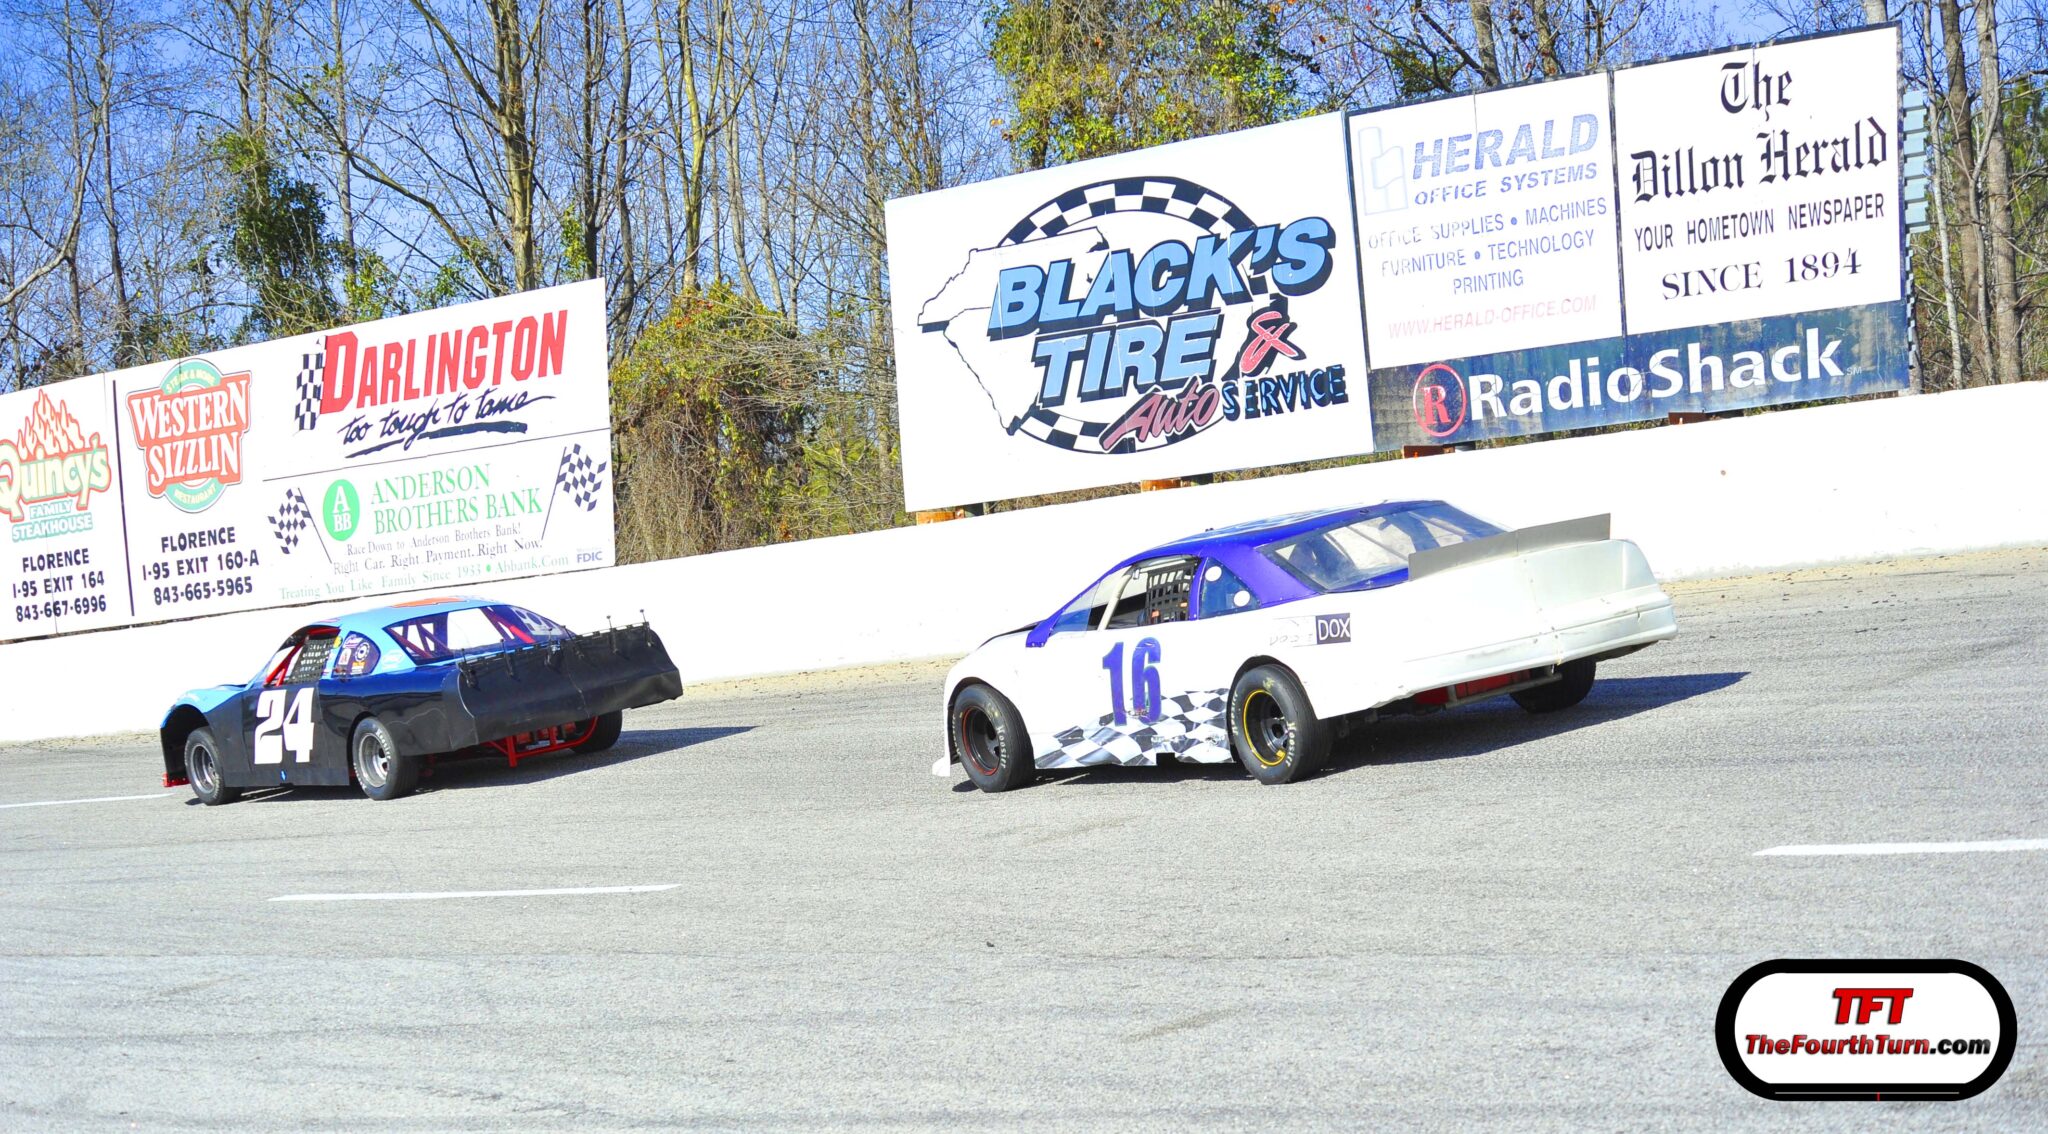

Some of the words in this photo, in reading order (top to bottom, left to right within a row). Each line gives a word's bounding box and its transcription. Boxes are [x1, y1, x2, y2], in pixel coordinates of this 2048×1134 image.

[1720, 61, 1792, 121] The
[1412, 113, 1599, 180] HERALD
[1630, 146, 1745, 204] Dillon
[1756, 117, 1888, 185] Herald
[1414, 181, 1487, 205] OFFICE
[1500, 162, 1597, 193] SYSTEMS
[1368, 226, 1422, 249] OFFICE
[1431, 214, 1504, 240] SUPPLIES
[1525, 197, 1607, 226] MACHINES
[1634, 224, 1674, 252] YOUR
[1687, 208, 1774, 245] HOMETOWN
[1788, 193, 1884, 230] NEWSPAPER
[1381, 249, 1467, 278] FURNITURE
[1488, 229, 1594, 261] TECHNOLOGY
[1662, 262, 1763, 300] SINCE
[1785, 248, 1861, 283] 1894
[986, 216, 1337, 342] BLACK'S
[1453, 269, 1524, 294] PRINTING
[1388, 295, 1596, 339] WWW.HERALD-OFFICE.COM
[319, 309, 568, 416] DARLINGTON
[1030, 312, 1224, 409] TIRE
[1469, 327, 1847, 422] RadioShack
[130, 380, 248, 441] WESTERN
[337, 414, 373, 446] too
[379, 398, 441, 451] tough
[442, 391, 470, 424] to
[475, 387, 557, 420] tame
[1099, 377, 1222, 453] Auto
[1221, 365, 1348, 422] SERVICE
[0, 433, 112, 522] Quincy's
[149, 432, 240, 488] SIZZLIN
[332, 486, 350, 513] A
[371, 463, 491, 505] ANDERSON
[12, 513, 93, 542] STEAKHOUSE
[29, 500, 73, 519] FAMILY
[333, 513, 353, 533] BB
[374, 496, 480, 536] BROTHERS
[486, 488, 543, 520] BANK
[22, 548, 90, 573] FLORENCE
[161, 526, 236, 553] FLORENCE
[333, 558, 359, 576] Right
[365, 556, 386, 571] Car.
[390, 553, 420, 570] Right
[426, 545, 476, 566] Payment.
[477, 541, 508, 559] Right
[514, 536, 543, 552] Now.
[347, 541, 368, 557] Race
[368, 537, 393, 554] Down
[397, 538, 405, 550] to
[410, 530, 450, 548] Anderson
[455, 527, 491, 543] Brothers
[496, 521, 522, 537] Bank!
[576, 550, 603, 564] FDIC
[13, 583, 37, 598] I-95
[43, 575, 74, 594] EXIT
[81, 570, 105, 589] 164
[142, 565, 170, 580] I-95
[177, 556, 209, 576] EXIT
[217, 549, 259, 571] 160-A
[279, 584, 321, 601] Treating
[326, 582, 345, 596] You
[350, 577, 373, 591] Like
[381, 572, 416, 590] Family
[423, 569, 451, 583] Since
[16, 594, 107, 622] 843-667-6996
[153, 576, 253, 605] 843-665-5965
[1318, 618, 1351, 641] DOX
[1102, 637, 1162, 727] 16
[254, 687, 315, 765] 24
